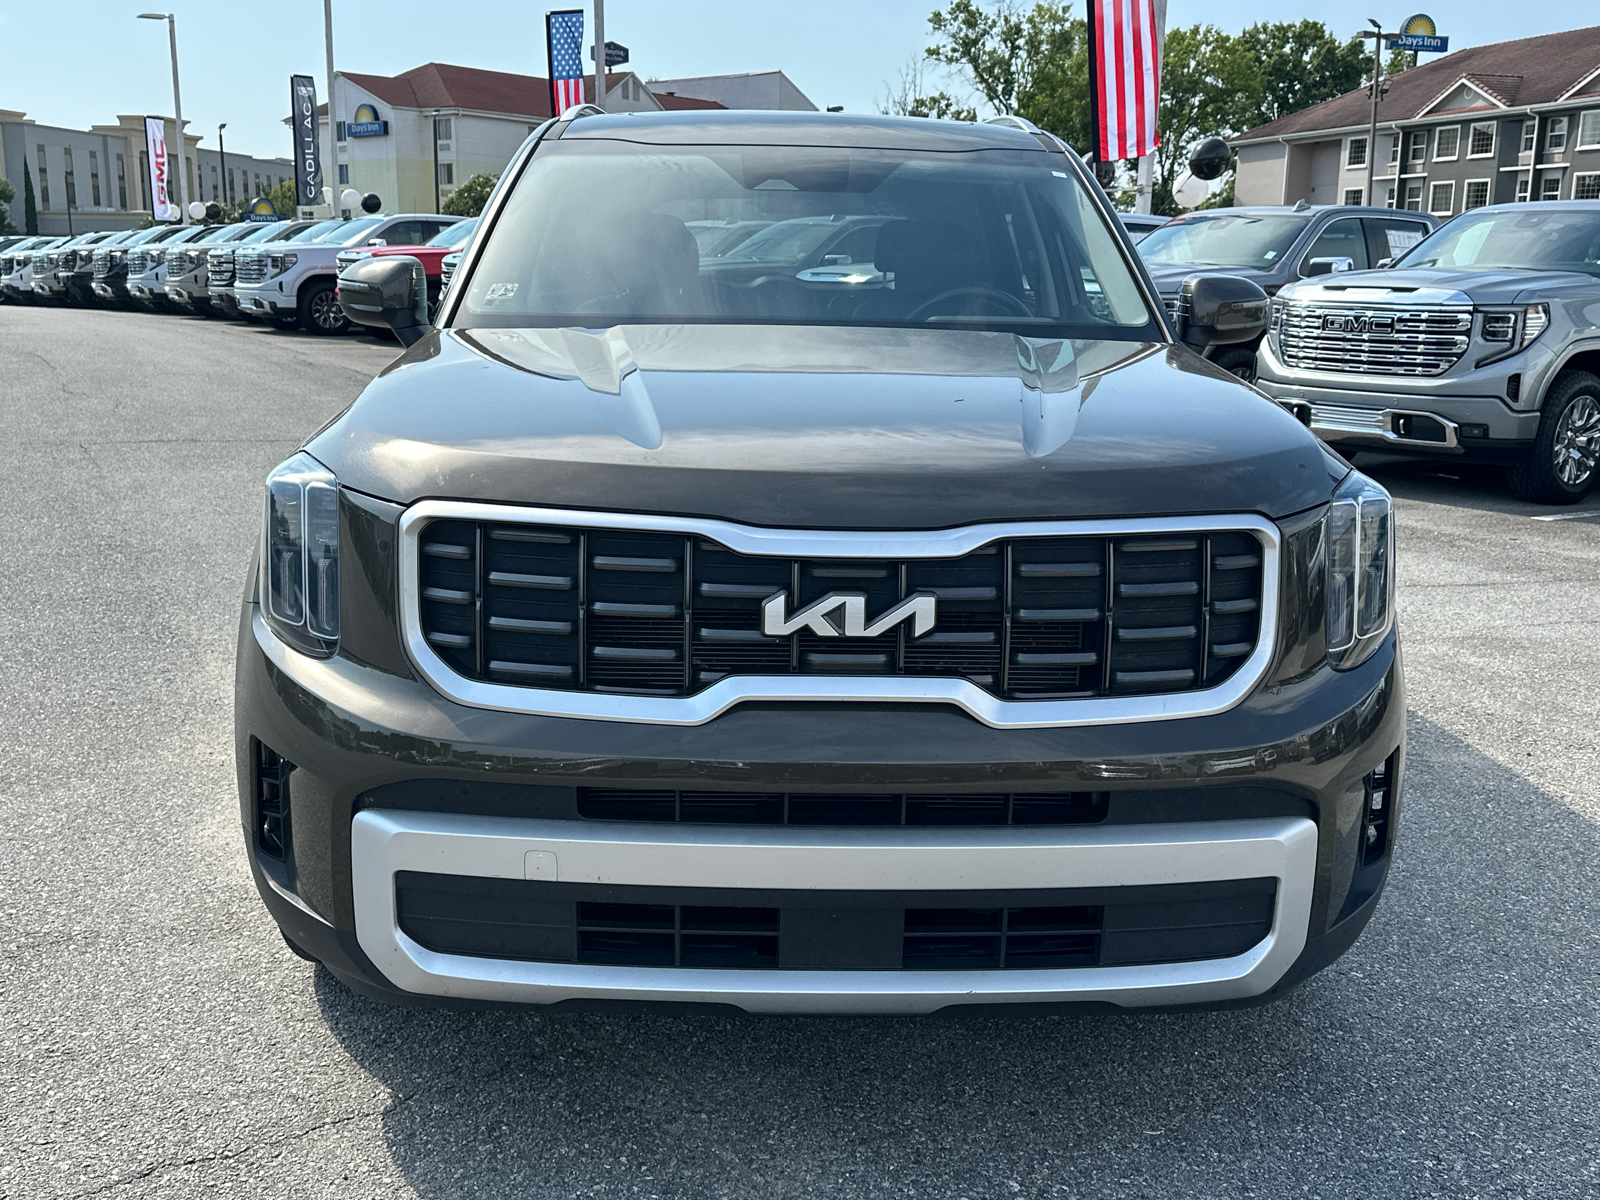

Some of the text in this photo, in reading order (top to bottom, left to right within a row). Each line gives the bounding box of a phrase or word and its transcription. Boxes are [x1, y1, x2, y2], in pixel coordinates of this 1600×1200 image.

[1398, 36, 1441, 46] Days Inn
[351, 123, 379, 132] Days Inn
[303, 103, 315, 198] CADILLAC
[153, 139, 166, 205] GMC
[1325, 315, 1394, 333] GMC
[761, 590, 938, 638] KIA
